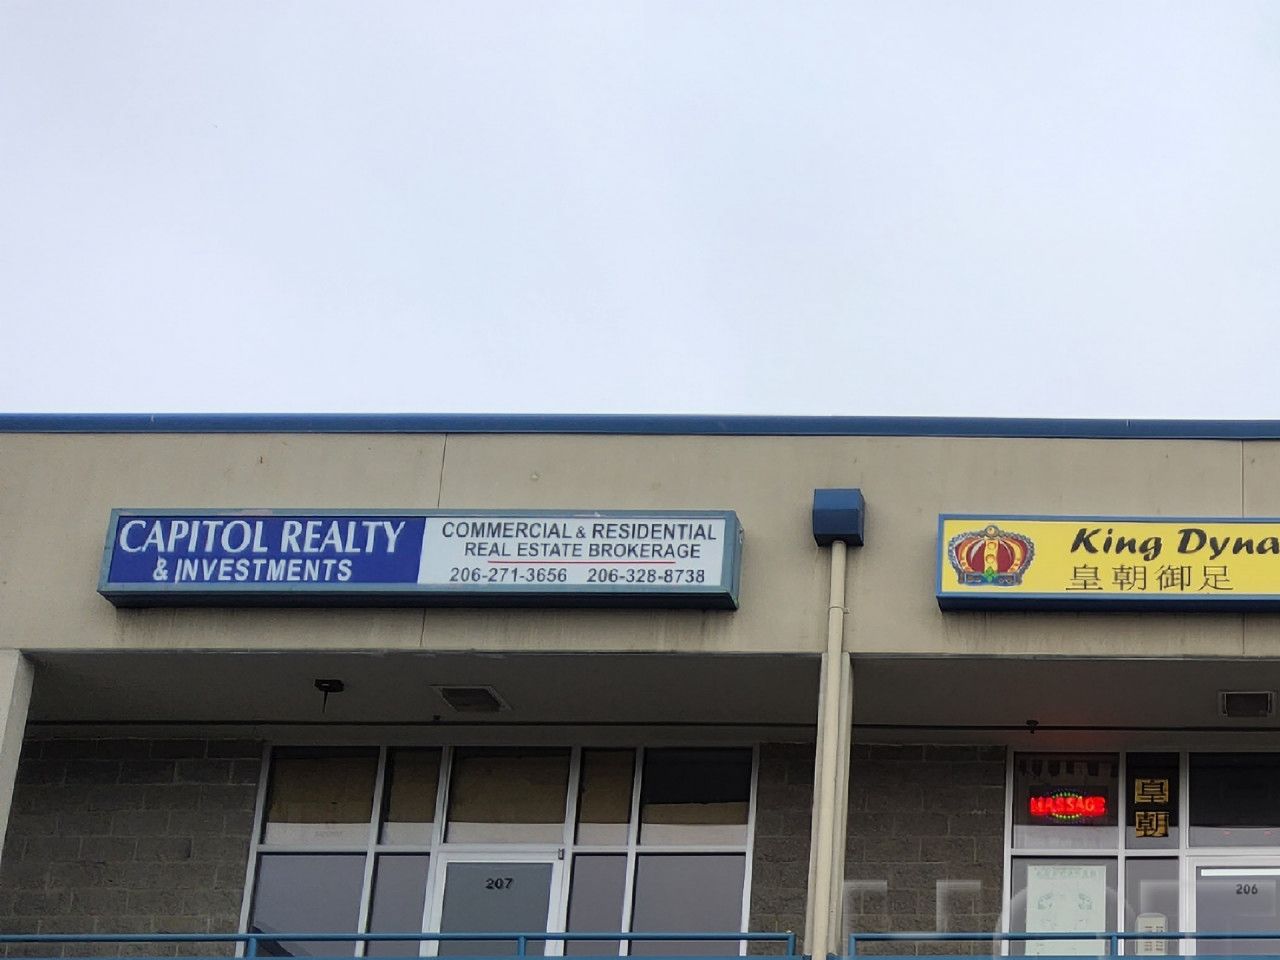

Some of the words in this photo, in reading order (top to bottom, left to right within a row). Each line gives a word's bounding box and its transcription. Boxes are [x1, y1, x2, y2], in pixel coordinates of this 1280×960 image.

[118, 519, 268, 553] CAPITOL
[280, 520, 406, 553] REALTY
[442, 522, 572, 538] COMMERCIAL
[576, 530, 587, 539] &
[592, 523, 717, 540] RESIDENTIAL
[464, 542, 511, 557] REAL
[517, 543, 583, 557] ESTATE
[589, 544, 701, 559] BROKERAGE
[1070, 528, 1163, 561] King
[152, 557, 169, 581] &
[175, 558, 353, 584] INVESTMENTS
[450, 568, 567, 583] 206-271-3656
[587, 568, 705, 583] 206-328-8738
[1066, 564, 1234, 592] 皇朝御足
[485, 877, 514, 890] 207
[1235, 883, 1259, 896] 206
